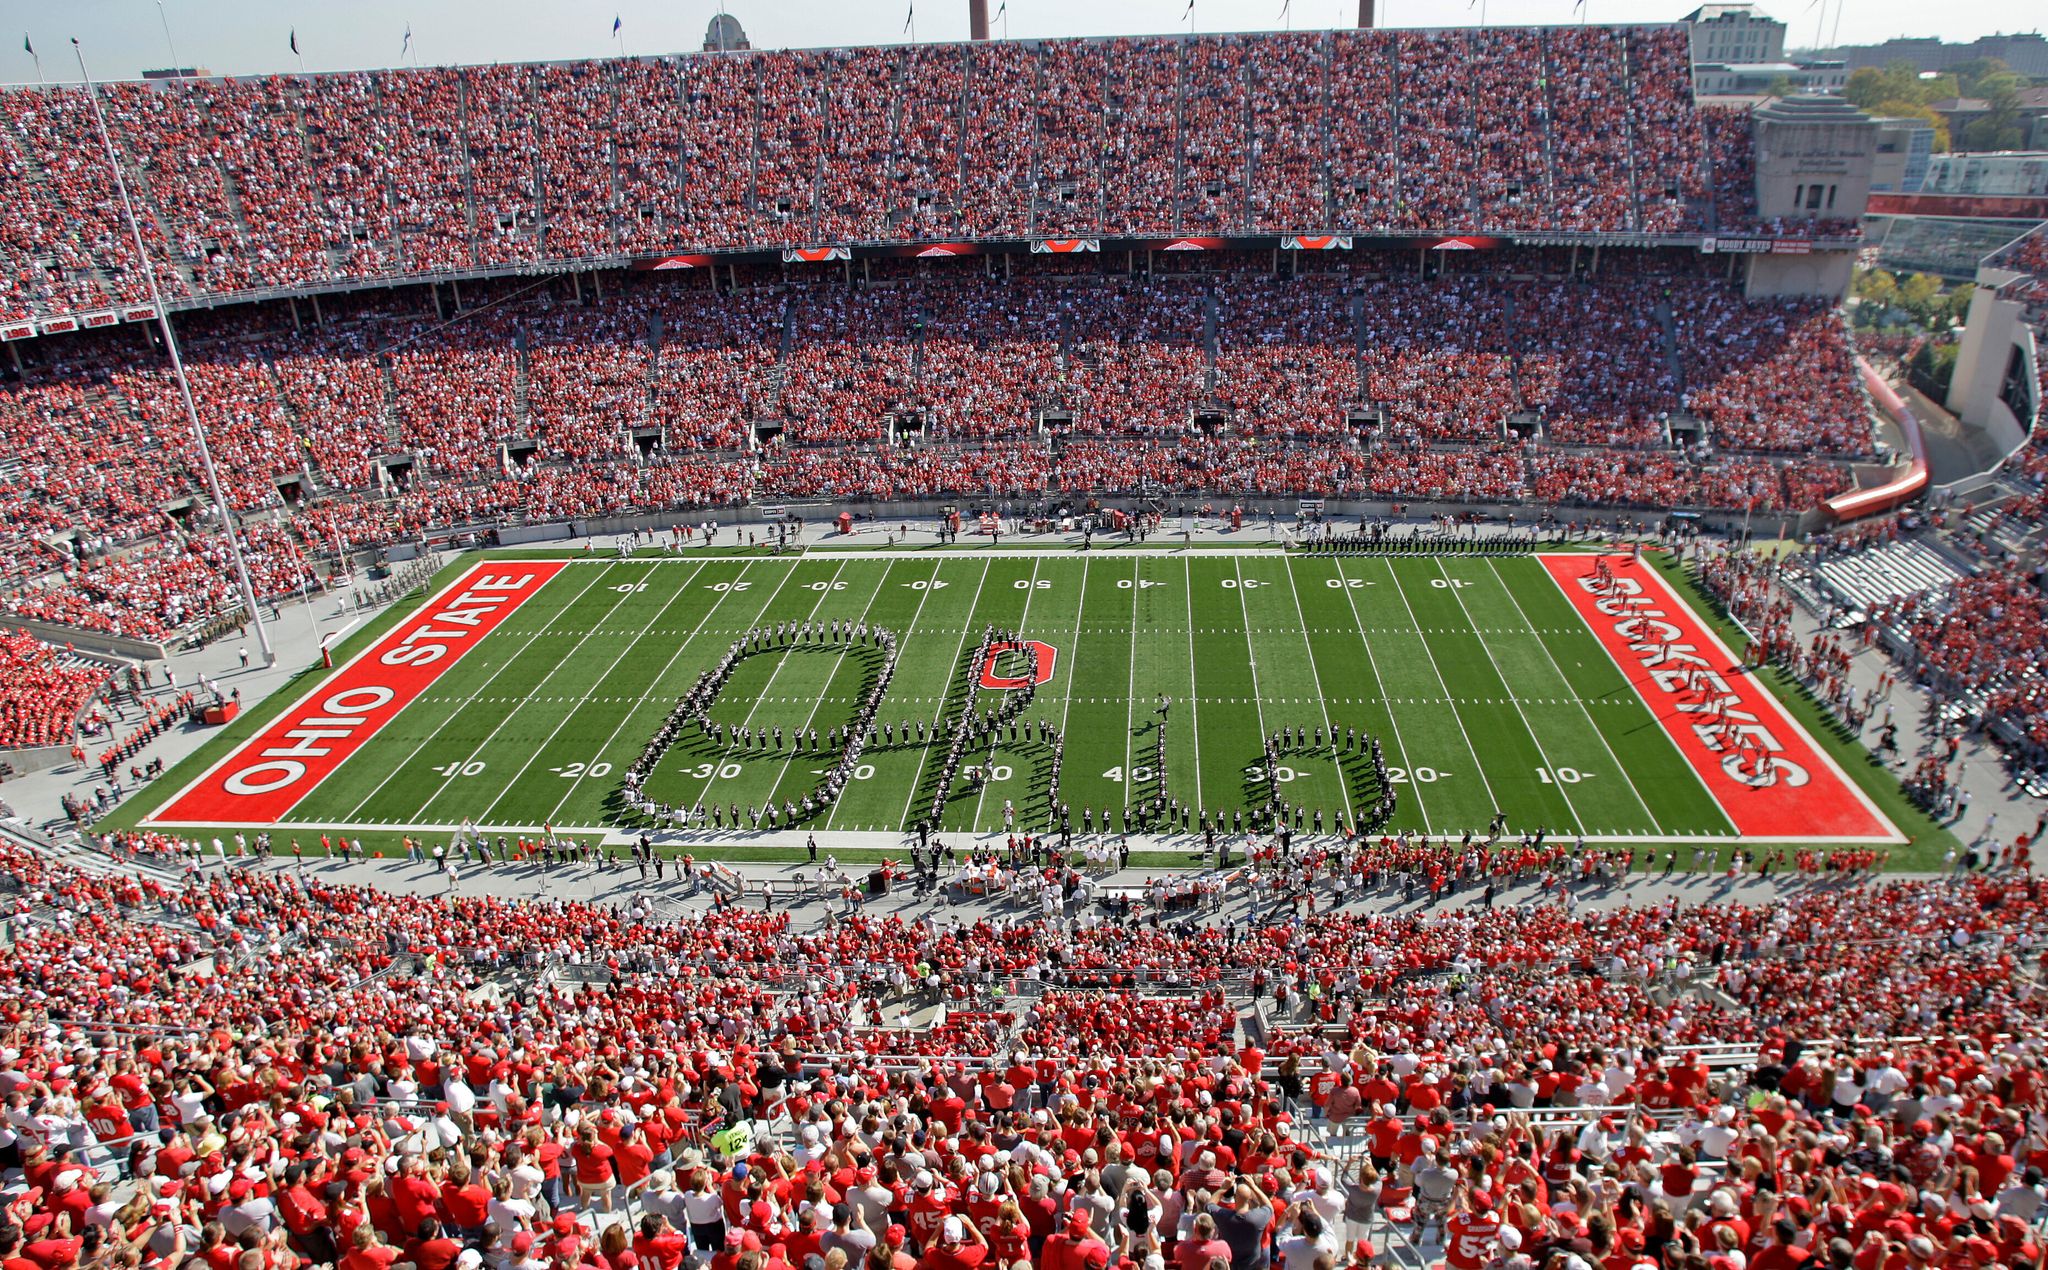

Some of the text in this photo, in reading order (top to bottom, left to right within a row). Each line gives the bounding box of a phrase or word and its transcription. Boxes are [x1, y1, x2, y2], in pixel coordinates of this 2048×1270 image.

[1717, 240, 1745, 249] WOODY
[1746, 241, 1771, 250] HAYES
[88, 315, 114, 326] 1970
[128, 309, 155, 320] 2002
[4, 327, 32, 339] 1961
[46, 321, 74, 333] 1968
[616, 583, 649, 593] 10
[712, 582, 752, 592] 20
[812, 581, 848, 591] 30
[912, 580, 949, 590] 40
[1014, 580, 1051, 589] 50
[1117, 580, 1158, 589] 40
[1221, 580, 1259, 589] 30
[1326, 579, 1365, 589] 20
[1431, 579, 1463, 588] 10
[224, 573, 535, 795] OHIO STATE
[1577, 577, 1811, 787] BUCKEYES
[441, 761, 486, 777] 10
[559, 763, 612, 778] 20
[692, 764, 742, 779] 30
[963, 766, 1013, 781] 50
[1102, 767, 1153, 782] 40
[1245, 767, 1294, 782] 30
[1389, 767, 1438, 783] 20
[1536, 767, 1581, 783] 10
[913, 1210, 941, 1231] 45
